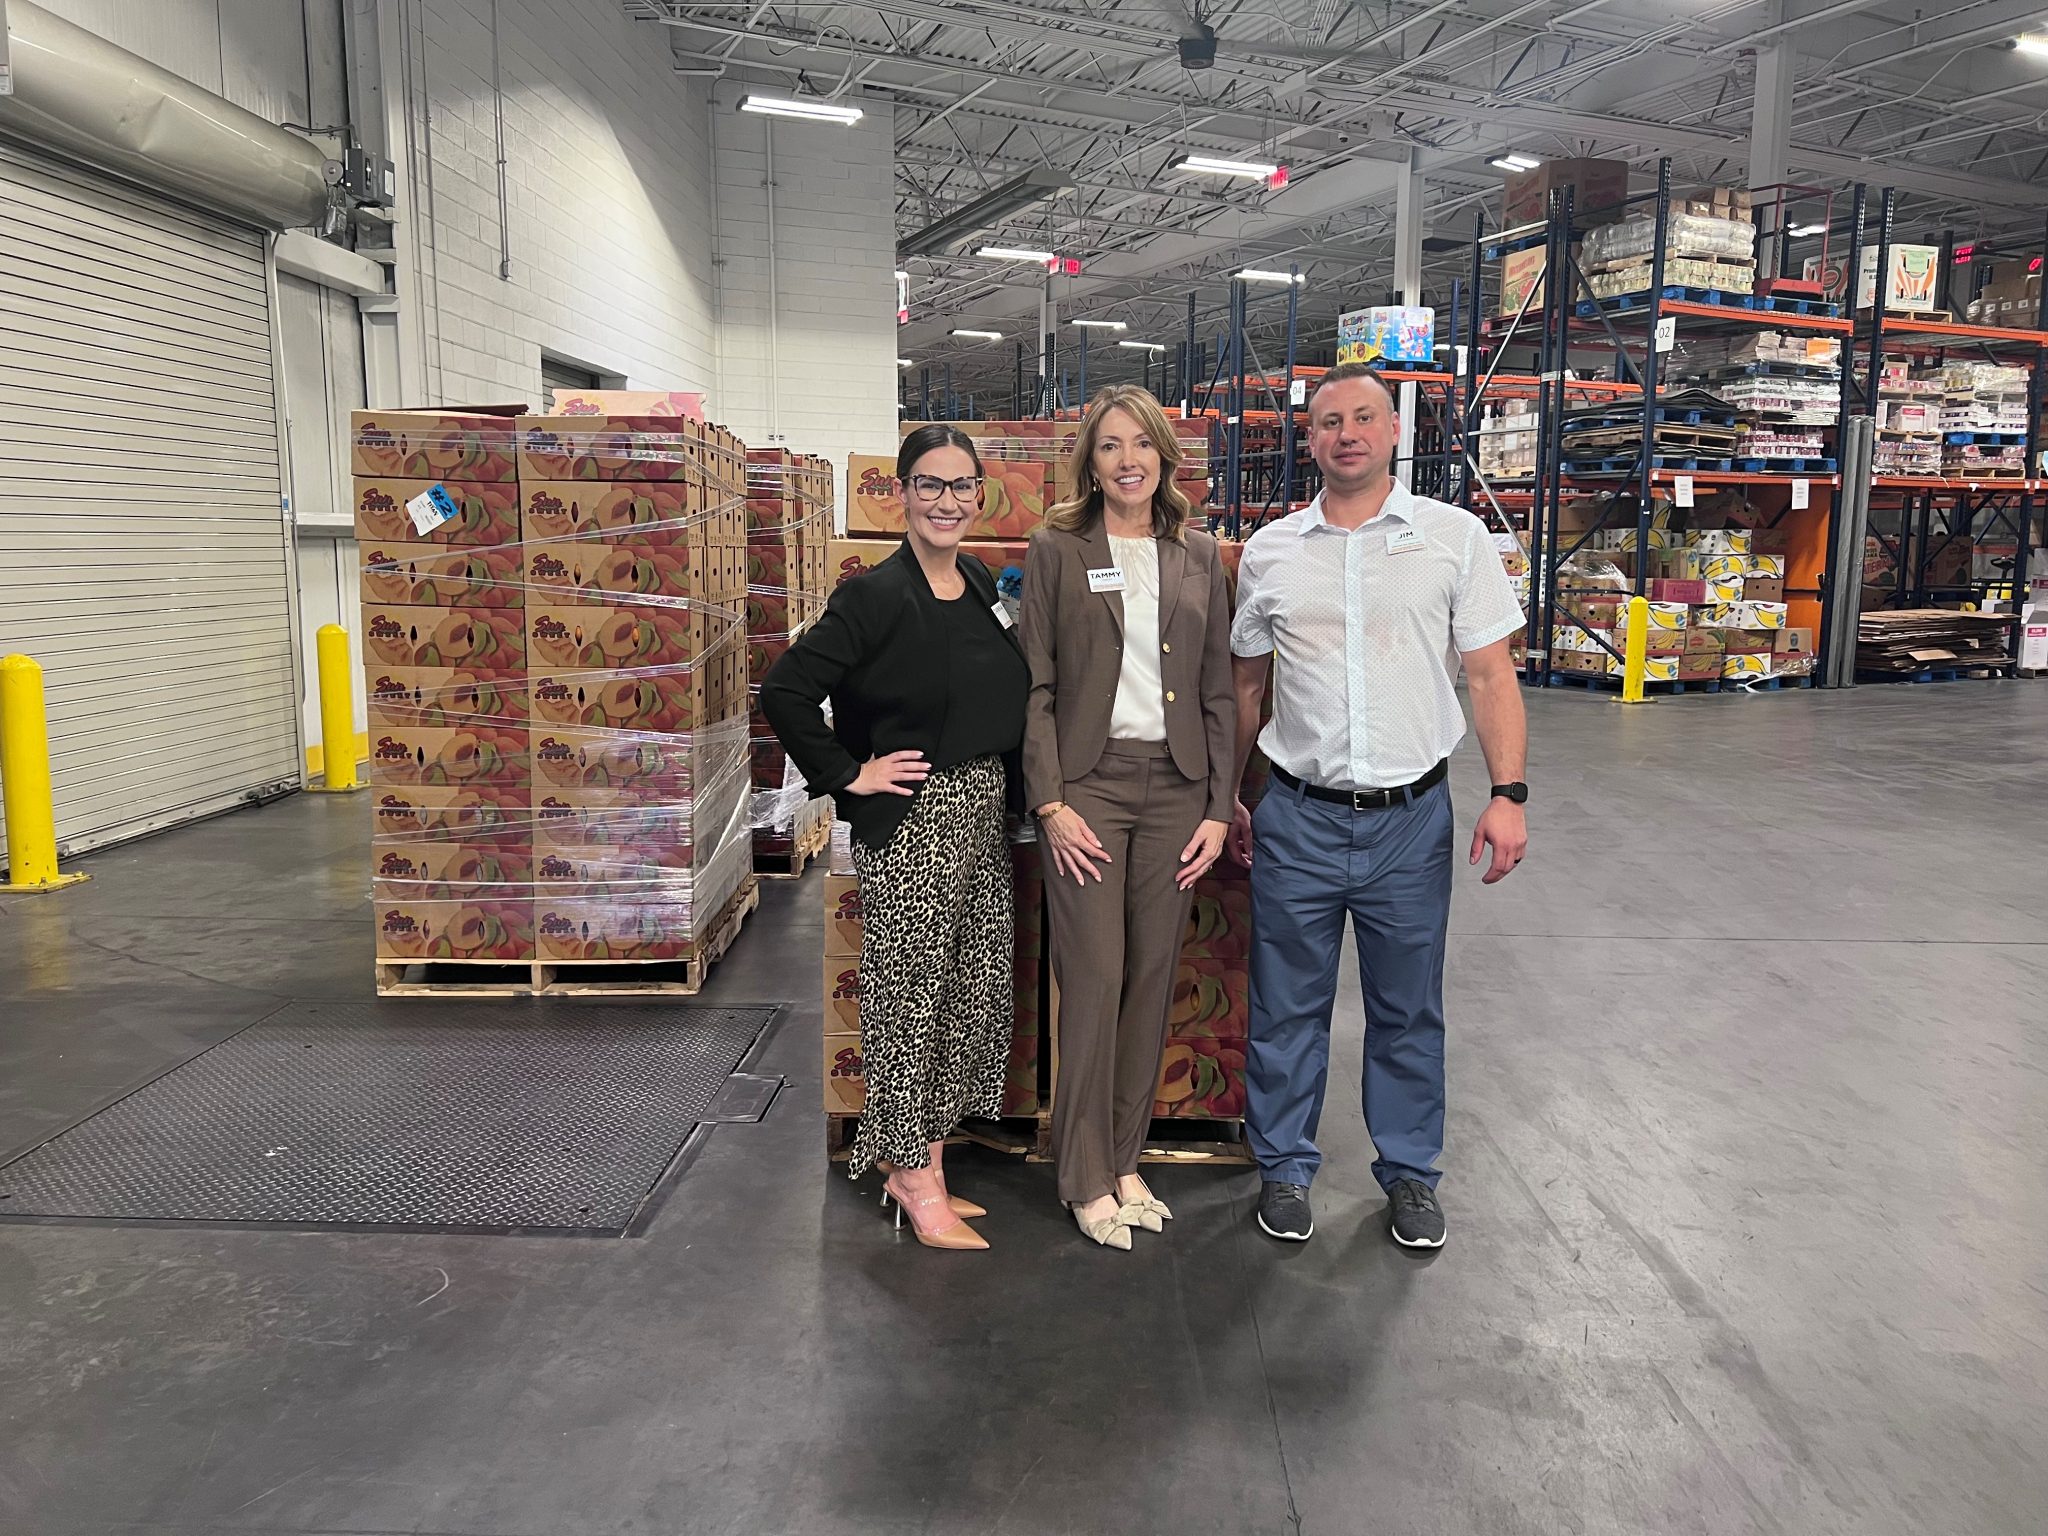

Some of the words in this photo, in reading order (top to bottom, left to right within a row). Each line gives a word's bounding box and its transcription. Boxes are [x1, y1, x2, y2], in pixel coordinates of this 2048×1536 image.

[1658, 326, 1671, 339] 02
[1292, 386, 1302, 396] 04
[563, 398, 600, 414] Sun
[1399, 531, 1414, 540] JIM
[1090, 571, 1121, 579] TAMMY
[838, 889, 862, 912] Su
[836, 969, 860, 992] Su
[834, 1047, 863, 1070] Su
